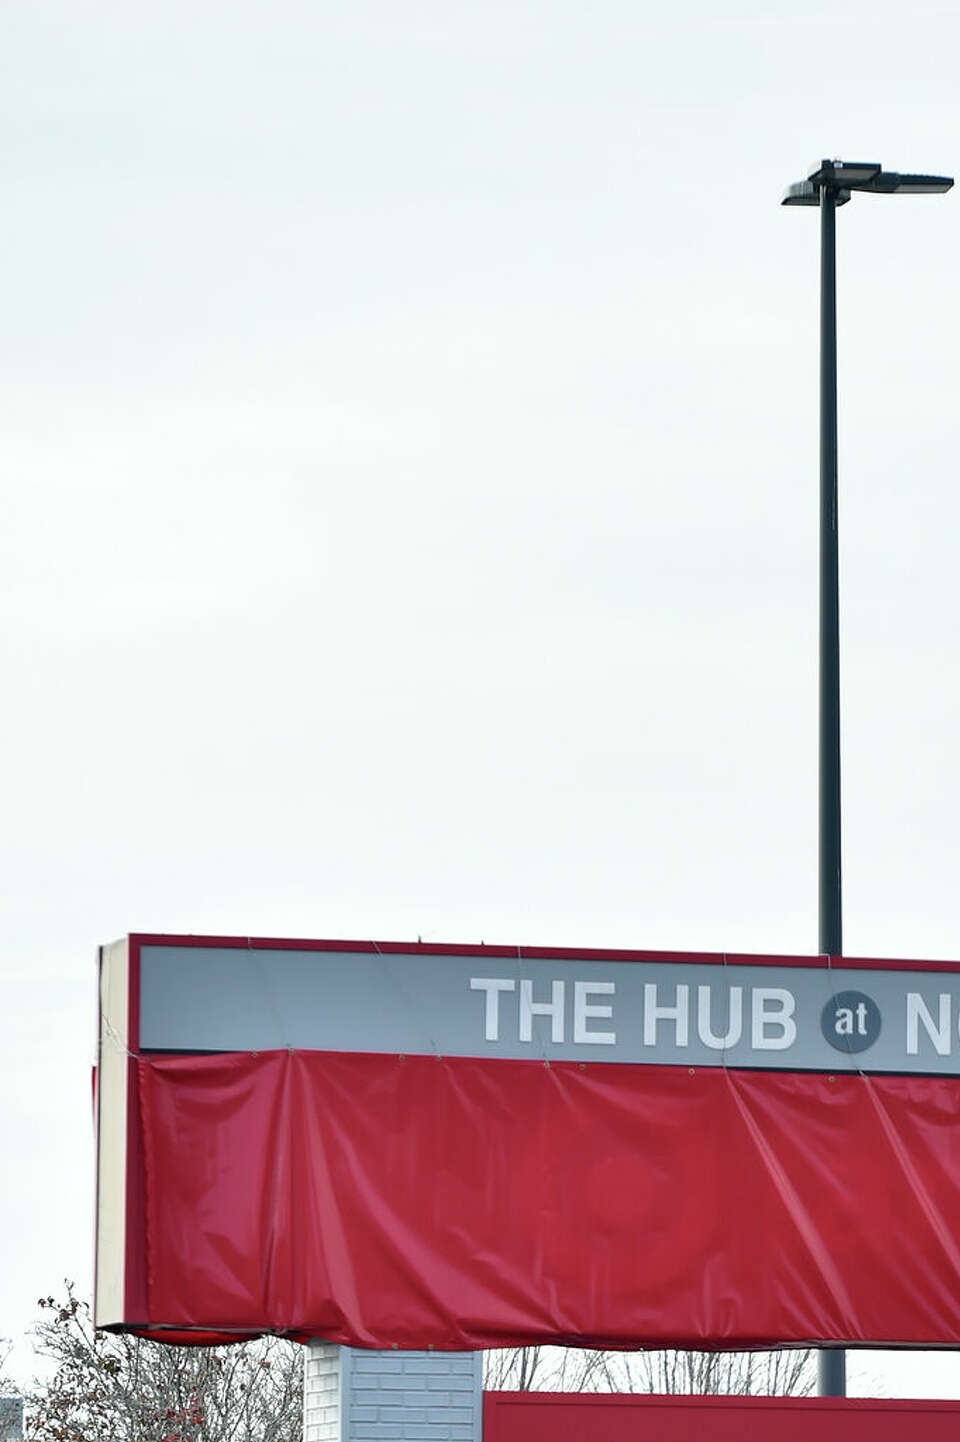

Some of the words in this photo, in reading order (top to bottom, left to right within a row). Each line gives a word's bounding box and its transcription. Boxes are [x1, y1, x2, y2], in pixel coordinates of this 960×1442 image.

[470, 978, 616, 1045] THE
[643, 984, 797, 1050] HUB
[834, 1002, 868, 1035] at
